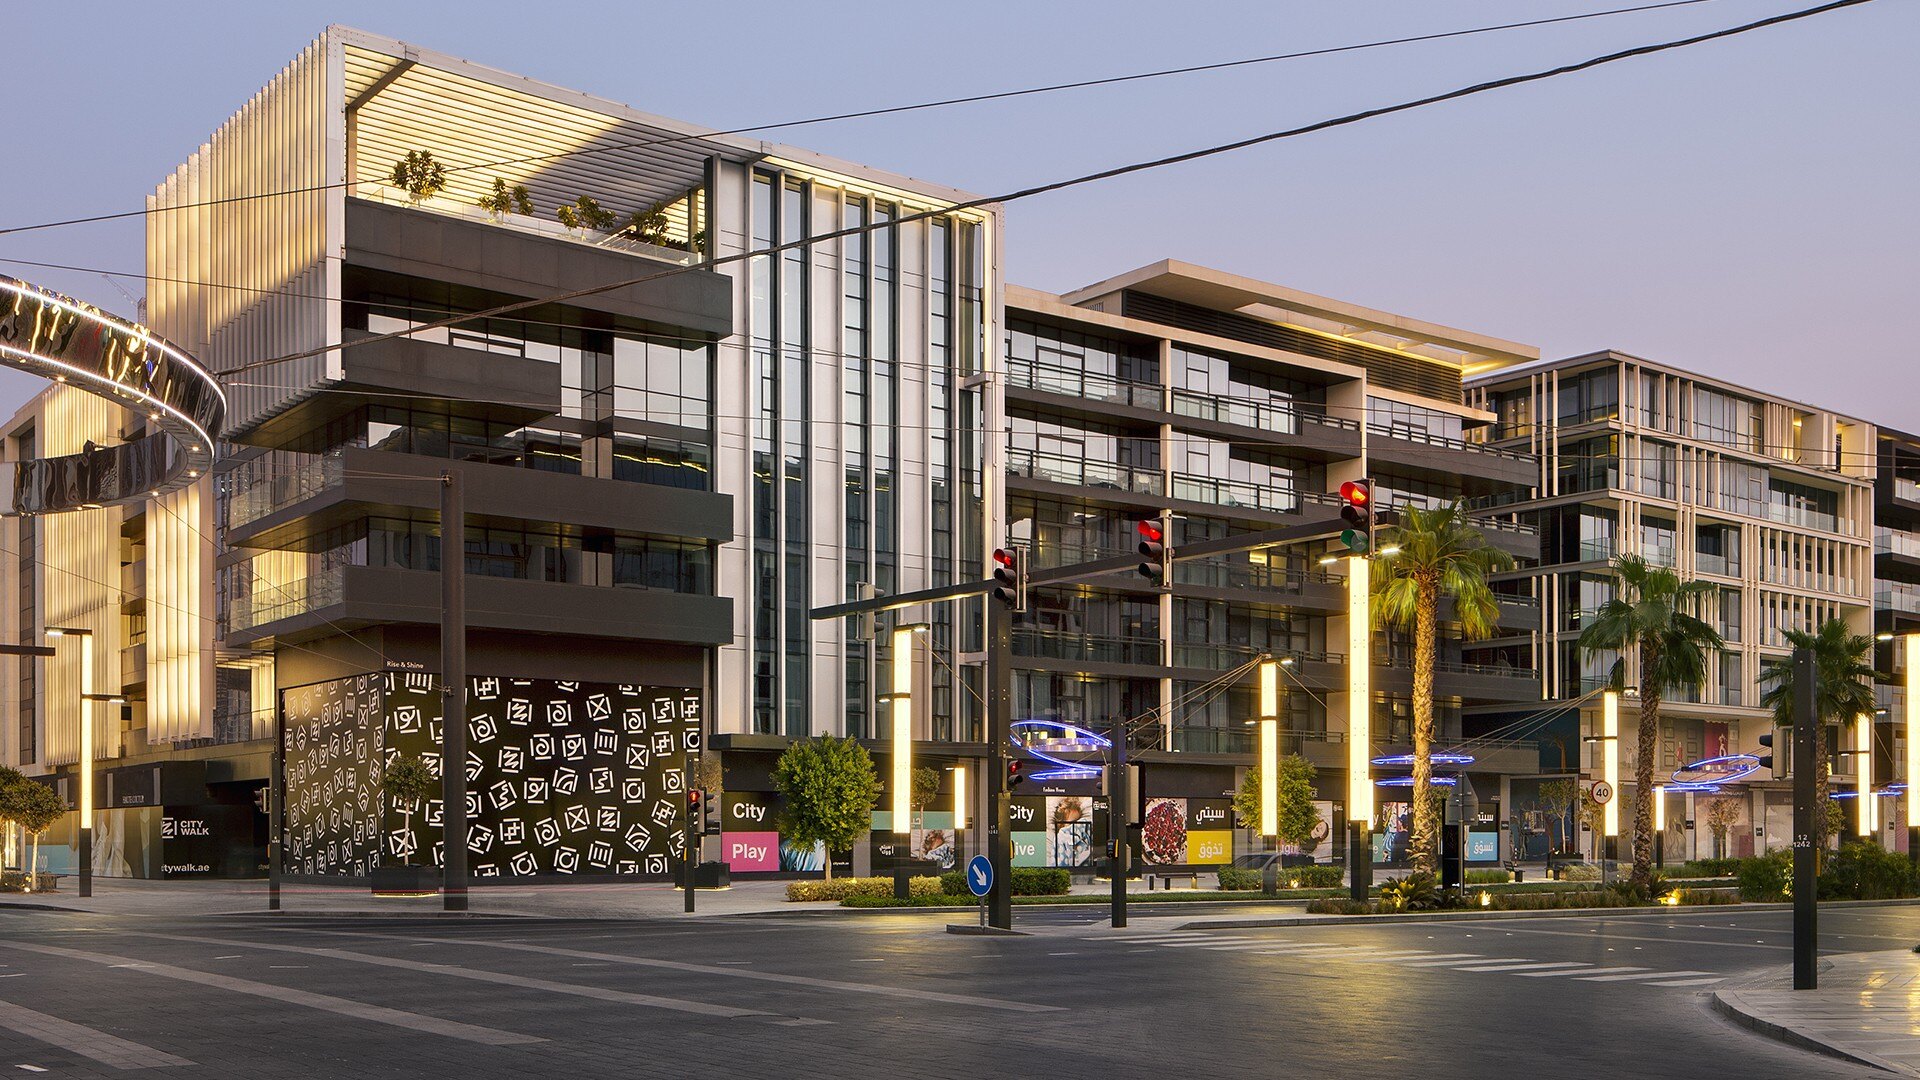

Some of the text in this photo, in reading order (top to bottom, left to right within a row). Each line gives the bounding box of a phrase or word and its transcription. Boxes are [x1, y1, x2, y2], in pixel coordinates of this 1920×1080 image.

[386, 660, 400, 668] Rise
[406, 661, 424, 669] Shine
[1595, 788, 1609, 798] 40
[732, 802, 766, 822] City
[1009, 804, 1035, 823] City
[1195, 806, 1225, 825] سيتي
[1477, 811, 1494, 824] سيت
[180, 820, 204, 828] CITY
[180, 828, 210, 836] WALK
[732, 843, 768, 862] Play
[1014, 841, 1036, 856] ive
